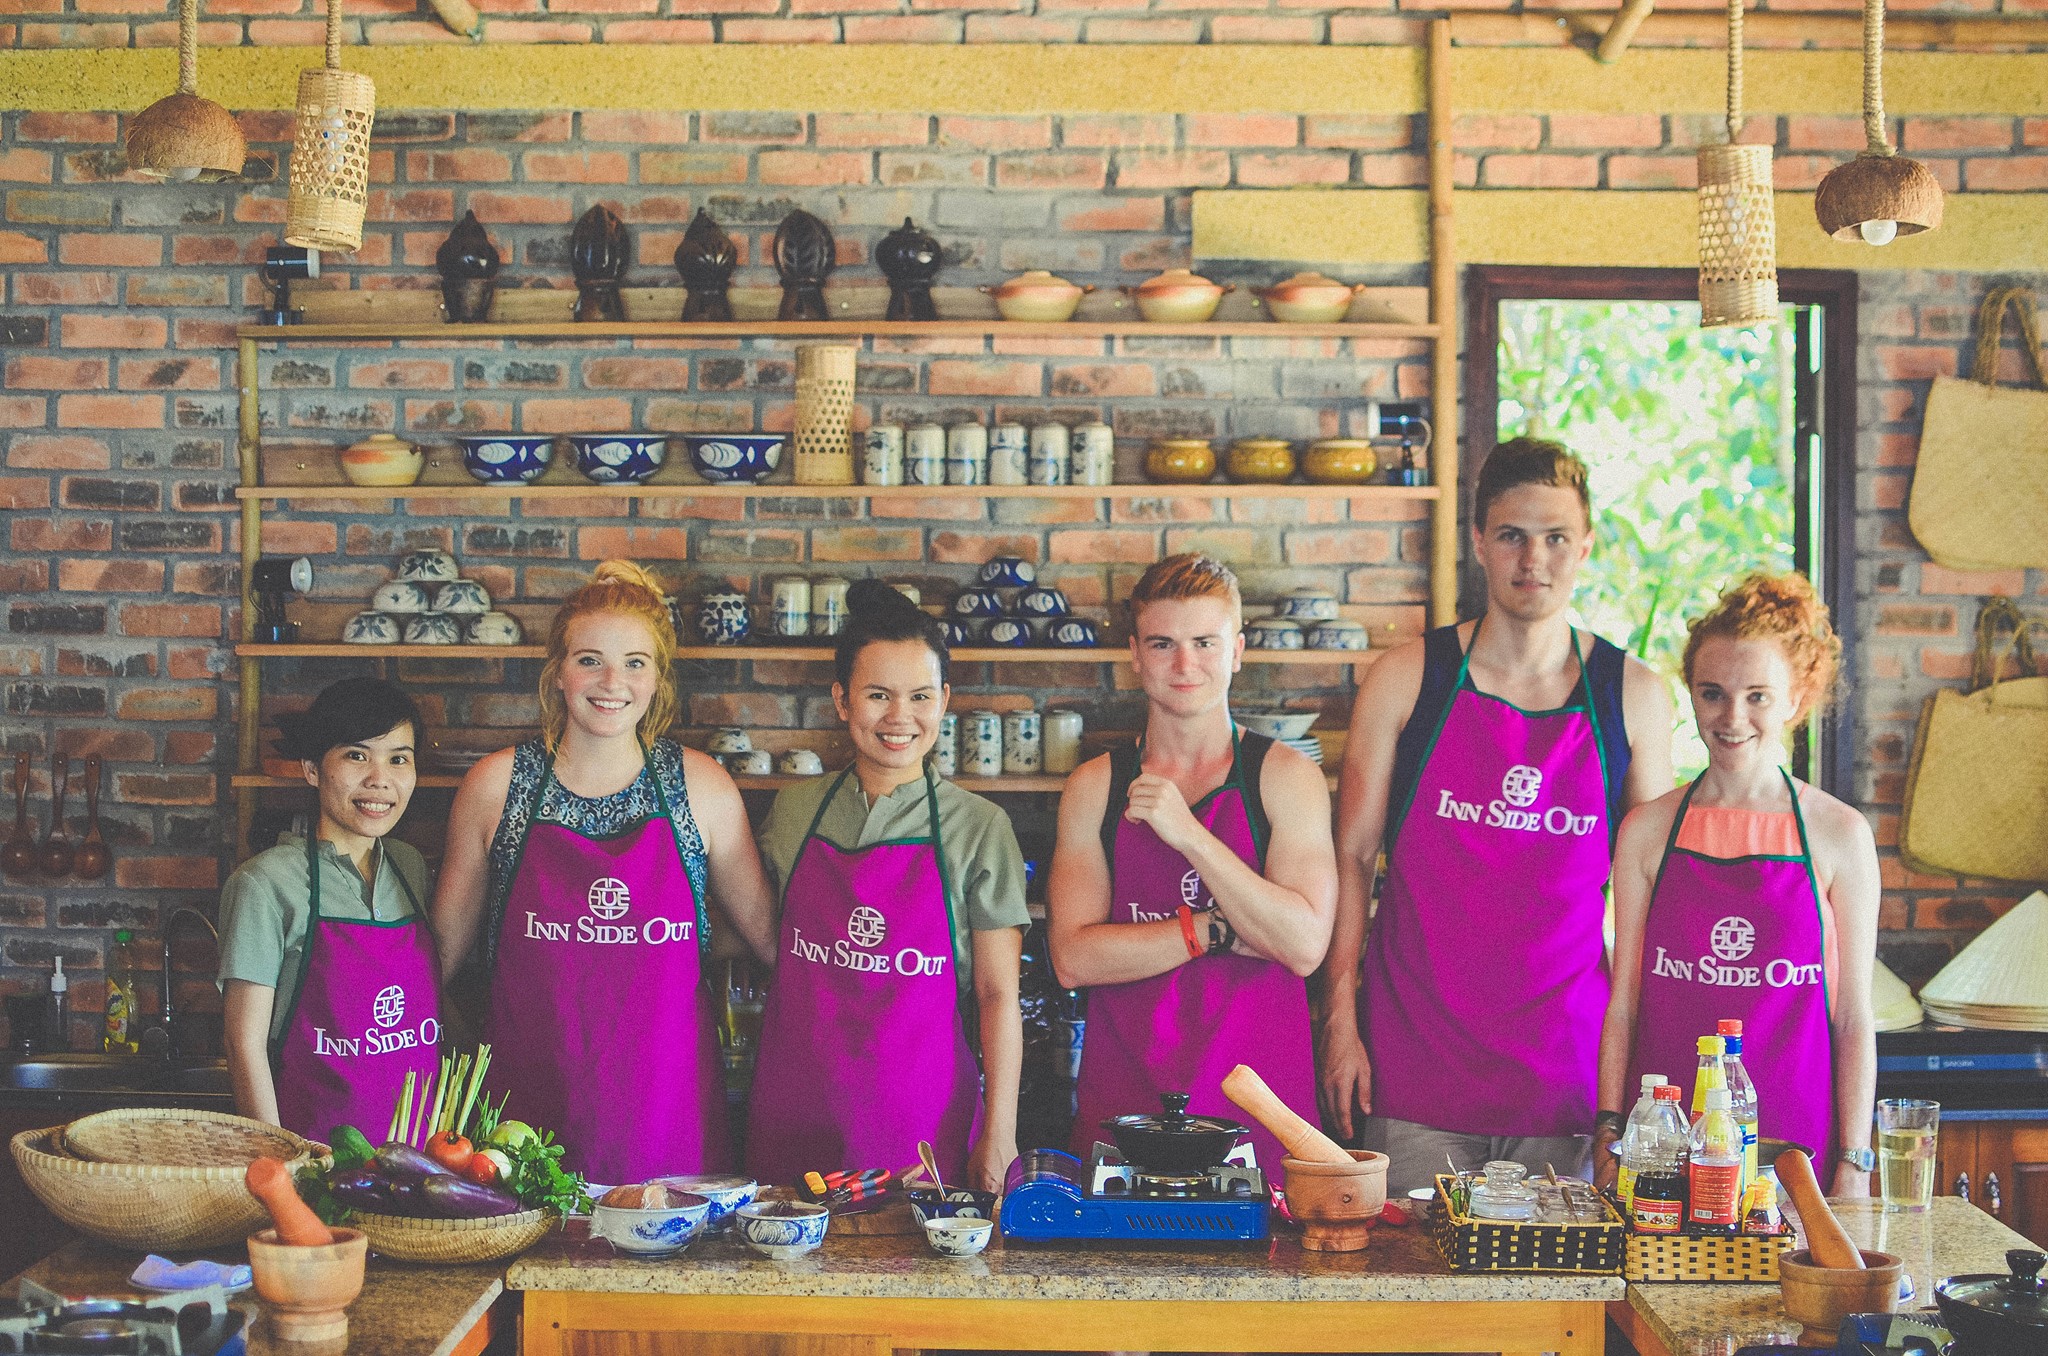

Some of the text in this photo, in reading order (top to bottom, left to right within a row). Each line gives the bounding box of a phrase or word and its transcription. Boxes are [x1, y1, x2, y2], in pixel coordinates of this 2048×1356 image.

[1436, 789, 1483, 823] INN
[1485, 799, 1541, 832] SIDE
[589, 889, 630, 907] HUE
[524, 911, 693, 945] INN SIDE OUT
[848, 916, 886, 937] HUE
[1711, 929, 1756, 948] HUE
[791, 927, 947, 976] INN SIDE OUT
[1652, 946, 1822, 988] INN SIDE OUT
[374, 996, 406, 1017] HUE
[313, 1027, 360, 1057] INN
[365, 1027, 418, 1055] SIDE
